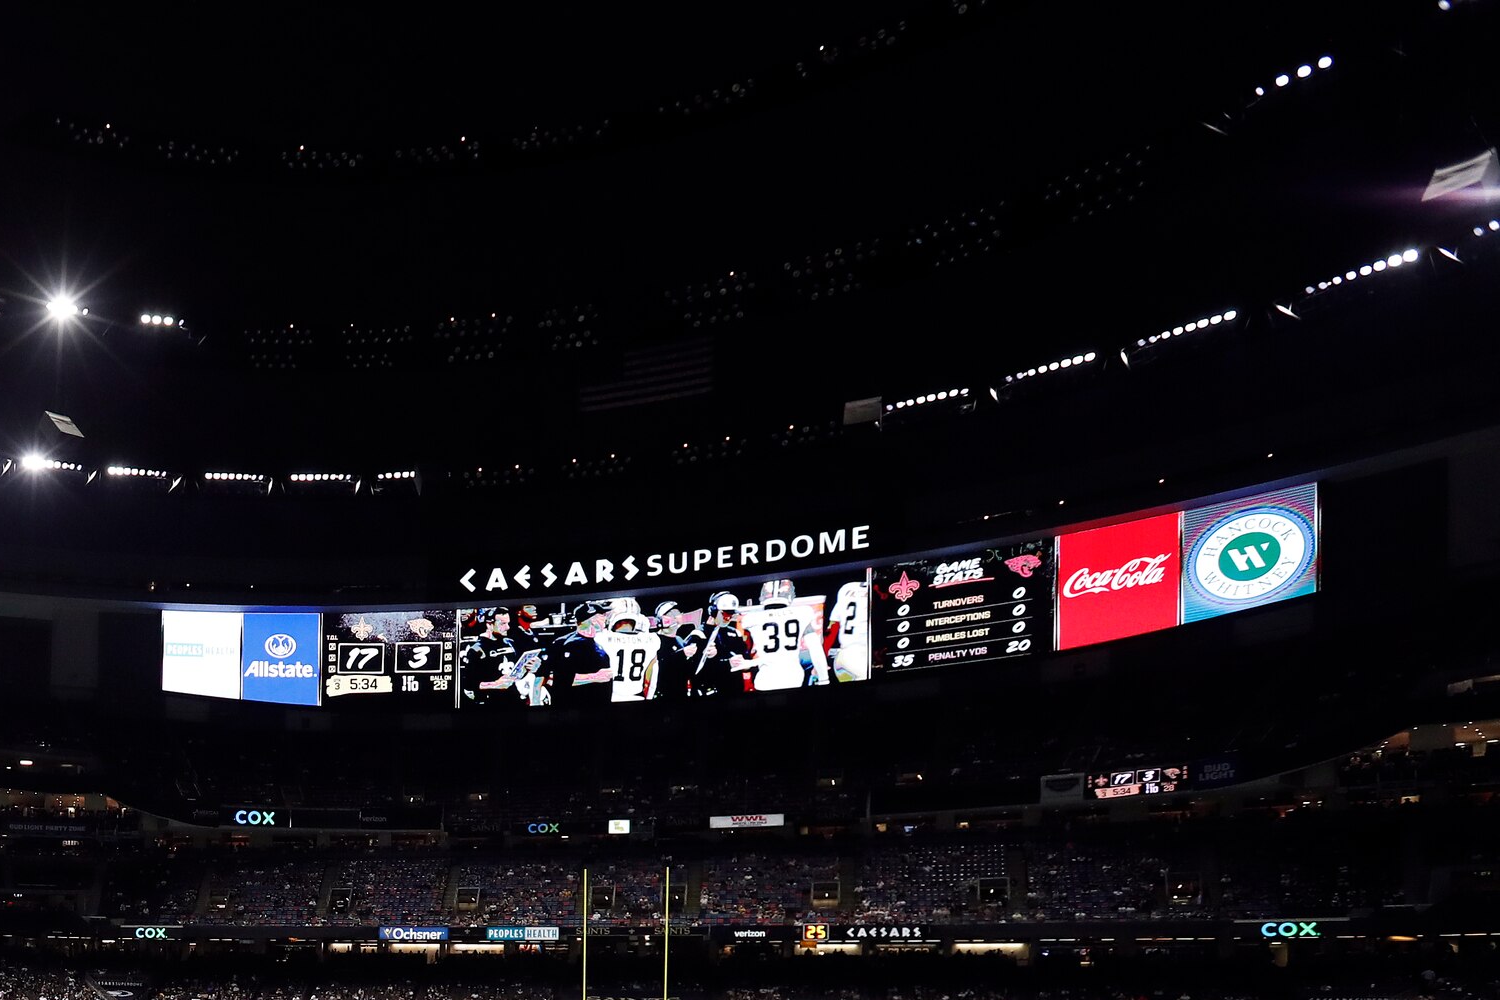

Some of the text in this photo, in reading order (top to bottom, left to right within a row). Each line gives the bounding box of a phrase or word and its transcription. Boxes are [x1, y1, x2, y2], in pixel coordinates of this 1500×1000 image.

[1203, 517, 1298, 557] HANCOCK
[459, 524, 871, 593] CAESARS SUPERDOME
[936, 557, 982, 575] GAME
[933, 567, 984, 586] STATS
[1062, 552, 1172, 598] Coca-Cola
[1204, 555, 1296, 596] WHITNEY
[897, 586, 1026, 617] 0 TURNOVERS 0
[897, 603, 1026, 633] 0 INTERCEPTIONS 0
[762, 619, 799, 653] 39
[897, 621, 1026, 649] 0 FUMBLES LOST 0
[346, 647, 379, 670] 17
[408, 646, 431, 669] 3
[892, 639, 1031, 668] 35 PENALTY YDS 20
[613, 649, 646, 682] 18
[349, 679, 378, 690] 5:34
[433, 680, 448, 691] 28
[1199, 769, 1236, 781] LIGHT
[1204, 763, 1231, 773] BUD
[1114, 773, 1132, 785] 17
[1142, 770, 1155, 782] 3
[1113, 787, 1131, 796] 5:34
[235, 810, 275, 825] COX
[528, 822, 559, 834] COX
[392, 927, 442, 940] Ochsner
[488, 927, 557, 939] PEOPLES HEALTH
[654, 927, 691, 935] SANTS
[734, 930, 766, 938] verizon
[806, 925, 826, 939] 25
[846, 927, 921, 938] CAESARS
